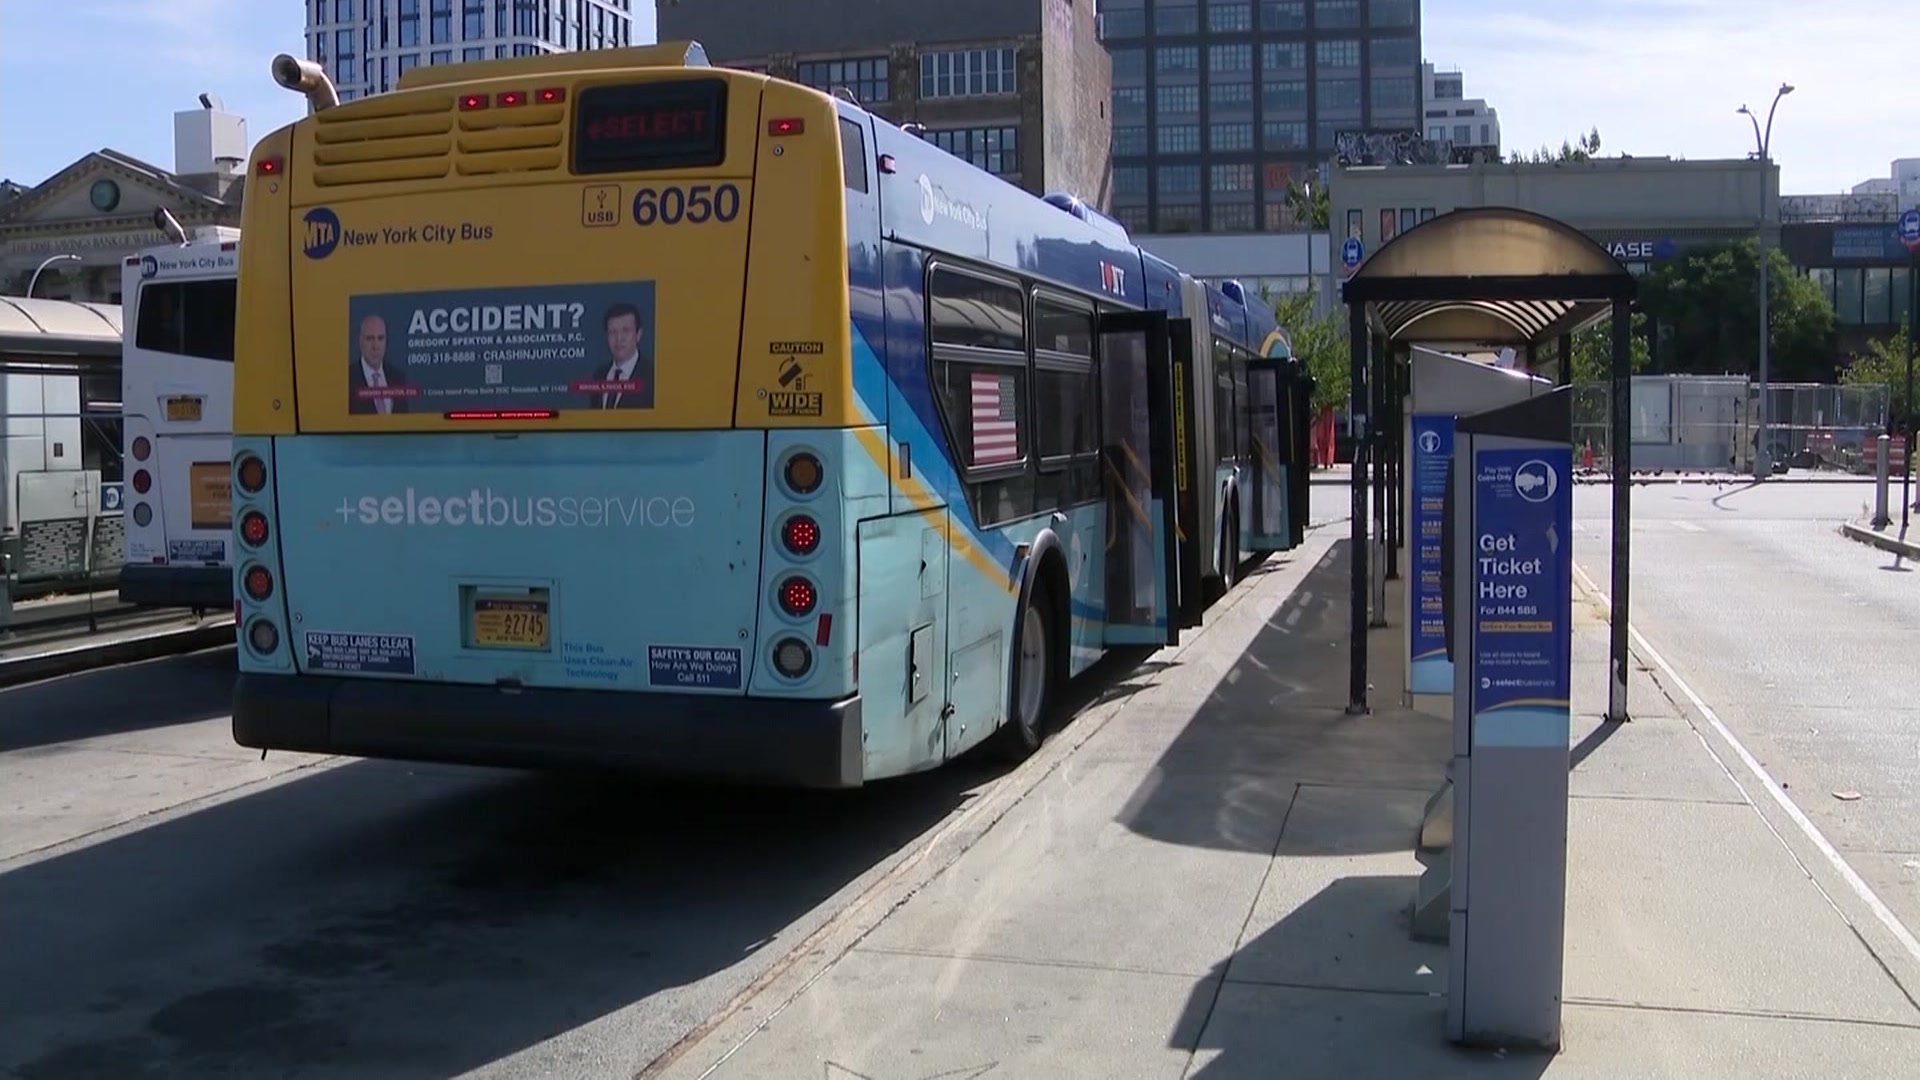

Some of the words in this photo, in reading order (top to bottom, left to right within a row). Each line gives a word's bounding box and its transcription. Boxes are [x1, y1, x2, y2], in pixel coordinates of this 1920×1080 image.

[633, 184, 739, 226] 6050
[588, 211, 613, 223] USB
[344, 229, 378, 246] New
[383, 227, 417, 245] York
[422, 224, 455, 245] City
[461, 222, 493, 240] Bus
[1600, 242, 1653, 257] HASE
[160, 260, 177, 270] New
[179, 259, 196, 269] York
[198, 258, 216, 269] City
[218, 256, 233, 266] Bus
[408, 302, 585, 335] ACCIDENT?
[408, 337, 449, 348] GREGORY
[452, 335, 493, 346] SPEKTOR
[496, 335, 503, 344] &
[505, 333, 566, 345] ASSOCIATES,
[772, 343, 821, 353] CAUTION
[408, 353, 431, 365] (800)
[433, 351, 475, 363] 318-8888
[483, 347, 585, 361] CRASHINJURY.COM
[771, 393, 820, 409] WIDE
[336, 487, 695, 526] +selectbusservice
[1479, 534, 1515, 552] Get
[1479, 557, 1541, 575] Ticket
[1479, 581, 1527, 599] Here
[1480, 605, 1496, 615] For
[1498, 605, 1515, 615] B44
[308, 633, 329, 645] KEEP
[331, 634, 348, 647] BUS
[350, 635, 378, 648] LANES
[380, 637, 410, 649] CLEAR
[564, 642, 583, 651] This
[586, 643, 604, 653] Bus
[564, 656, 587, 665] Uses
[590, 656, 633, 667] Clean-Air
[651, 648, 691, 660] SAFETY'S
[693, 649, 711, 661] OUR
[714, 650, 738, 662] GOAL
[566, 668, 620, 681] Technology
[651, 660, 671, 669] How
[673, 660, 688, 670] Are
[689, 661, 704, 671] We
[706, 662, 737, 675] Doing?
[677, 671, 694, 683] Call
[697, 673, 710, 684] 511
